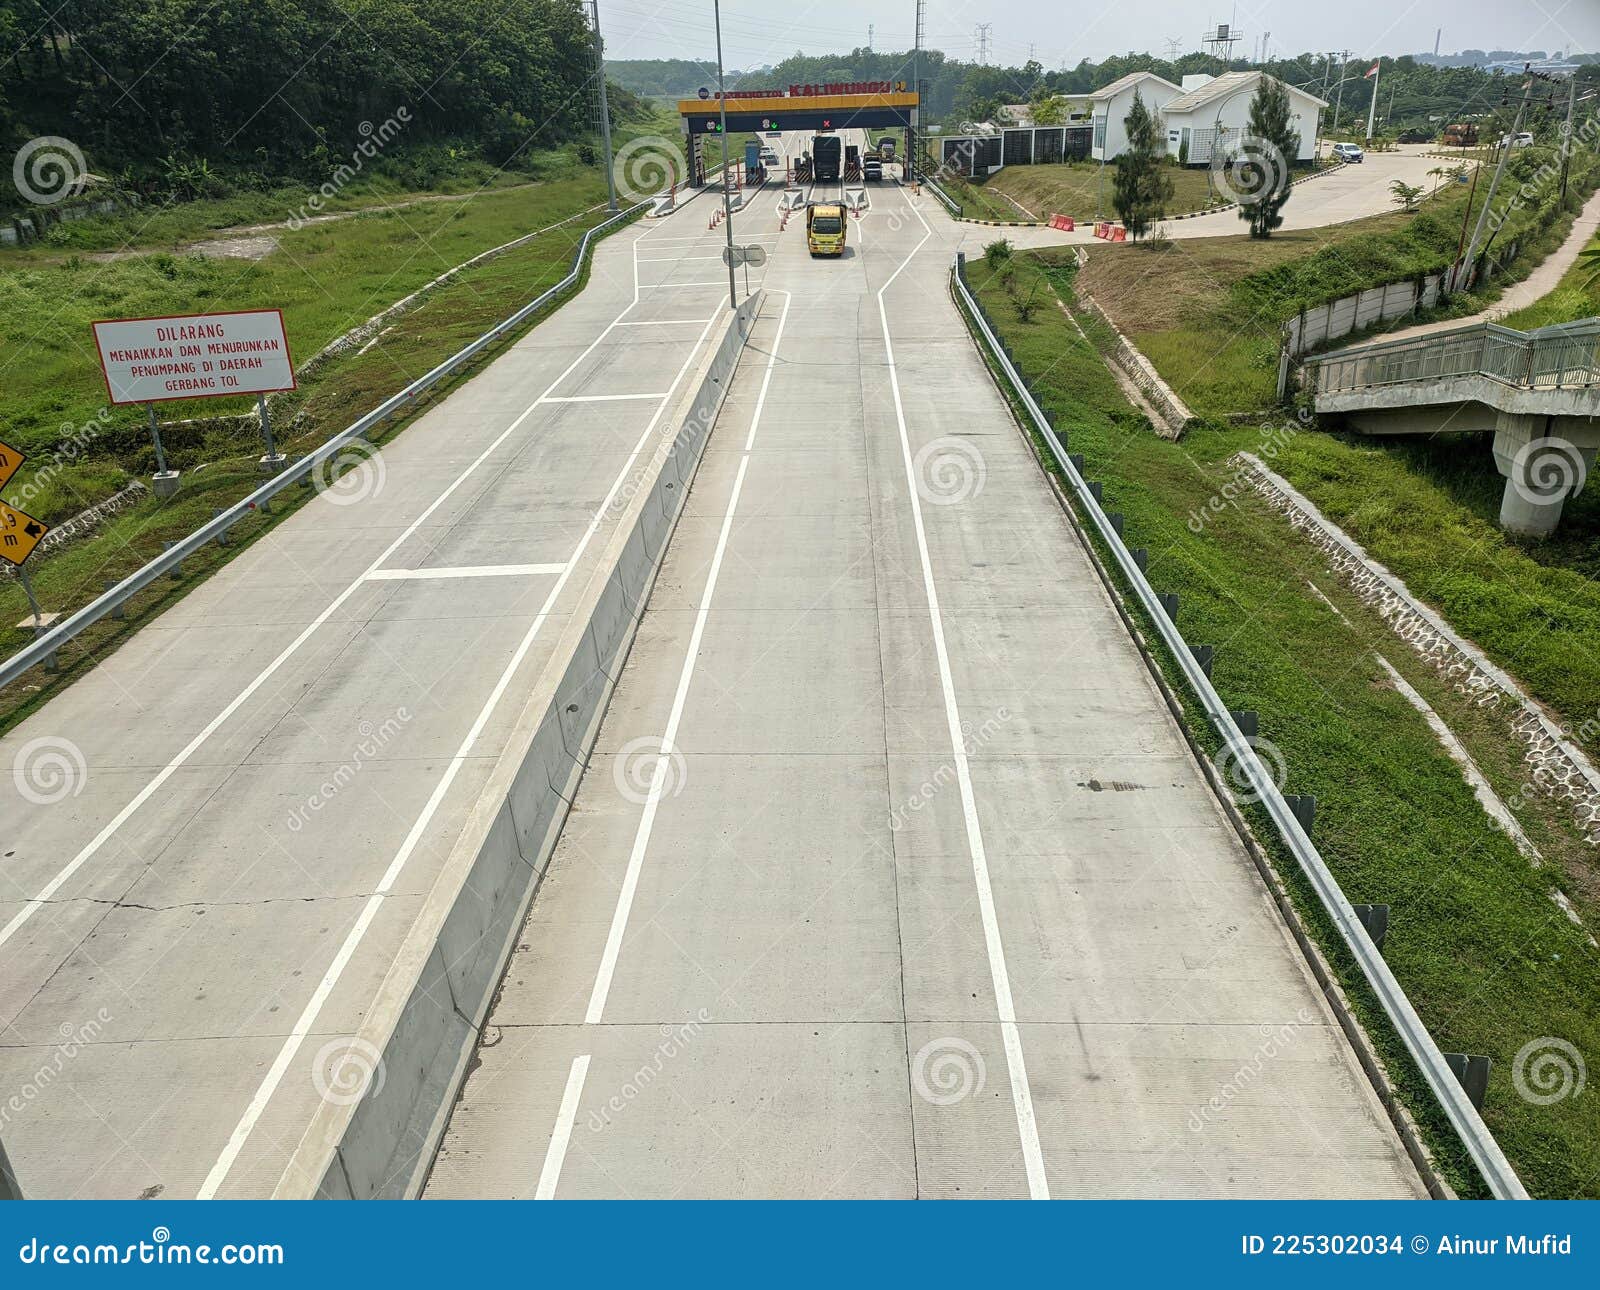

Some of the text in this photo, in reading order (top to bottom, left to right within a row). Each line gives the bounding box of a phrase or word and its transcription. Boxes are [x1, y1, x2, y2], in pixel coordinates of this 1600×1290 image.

[157, 324, 225, 342] DILARANG
[110, 339, 279, 362] MENAIKKAN DAN MENURUNKAN
[131, 357, 263, 378] PENUMPANG DI DAERAH
[165, 375, 240, 392] GERBANG TOL
[3, 534, 18, 546] m
